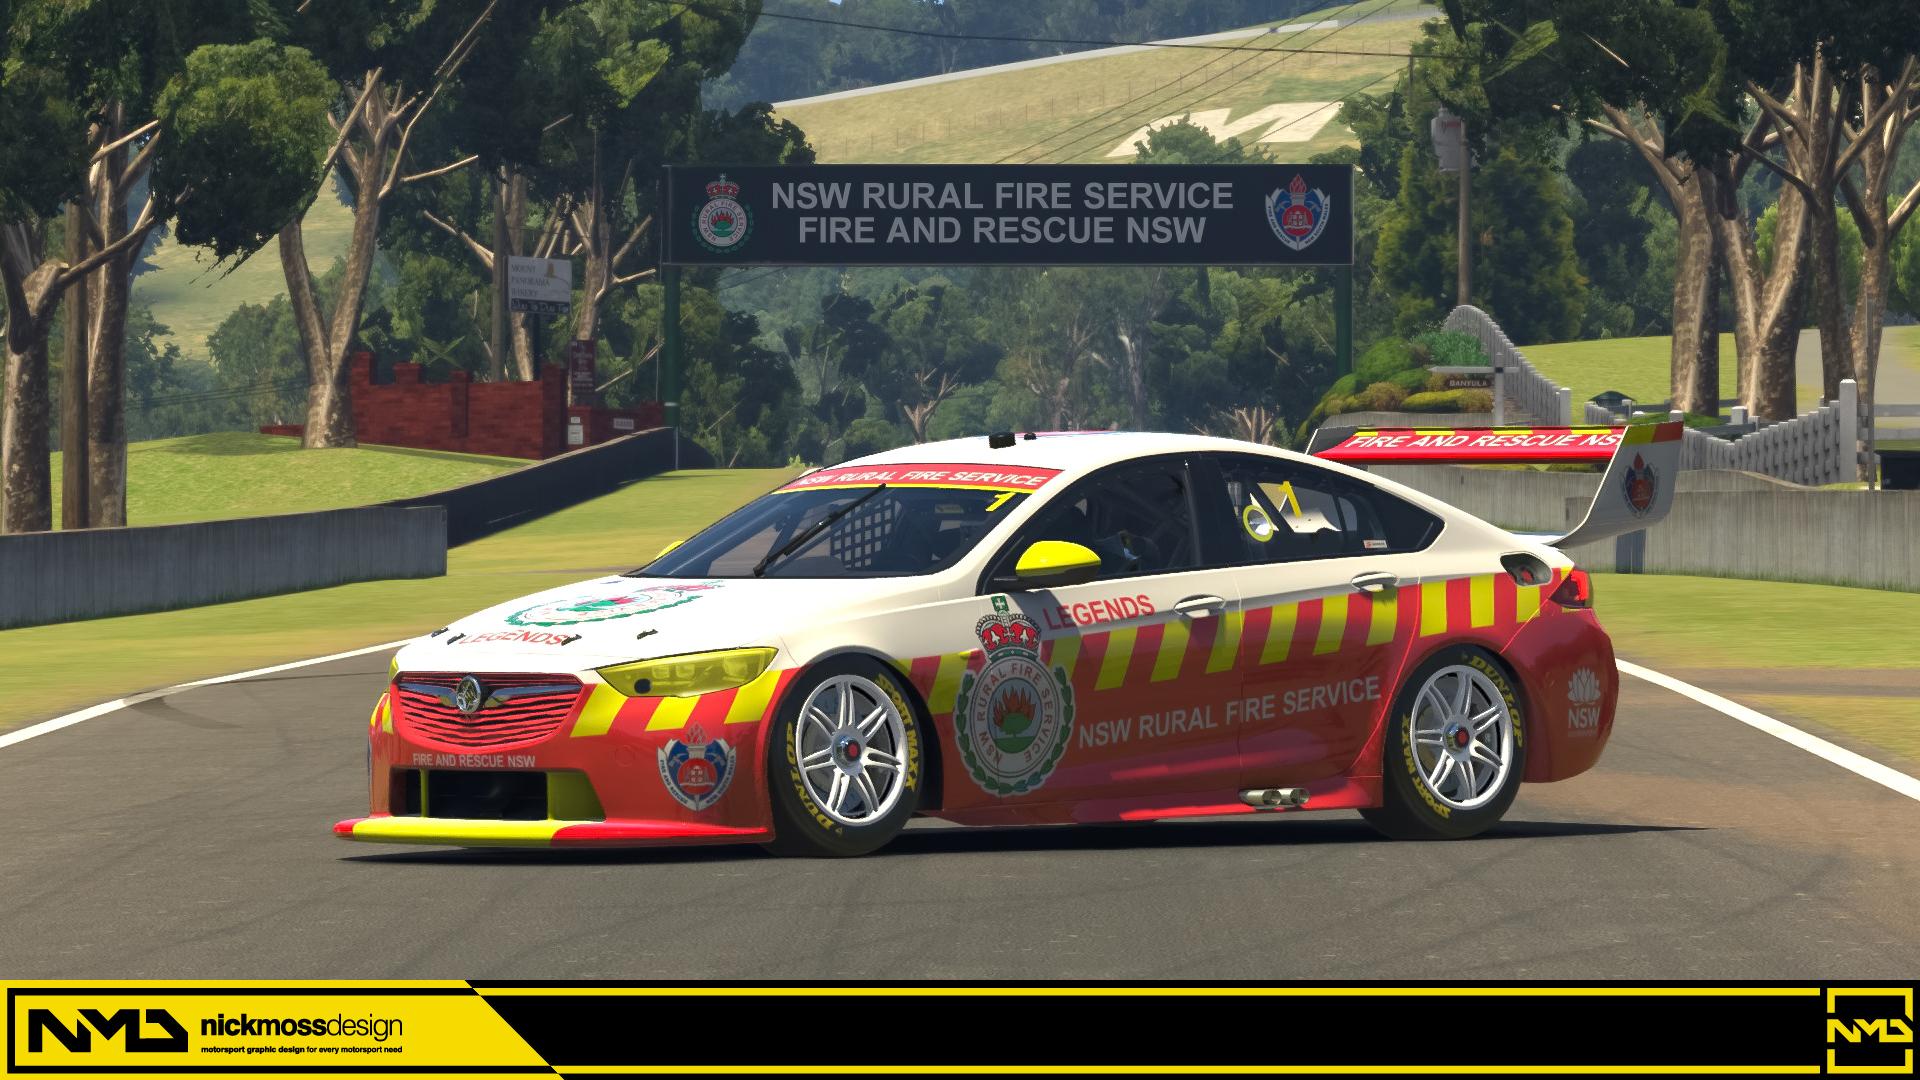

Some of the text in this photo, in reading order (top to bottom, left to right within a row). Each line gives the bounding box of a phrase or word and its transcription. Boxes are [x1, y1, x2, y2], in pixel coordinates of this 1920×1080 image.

[772, 182, 1233, 209] NSW RURAL FIRE SERVICE
[799, 216, 1206, 244] FIRE AND RESCUE NSW
[1345, 434, 1622, 448] FIRE AND RESCUE NS
[835, 471, 898, 483] RURAL
[899, 471, 945, 482] FIRE
[948, 471, 1048, 487] SERVICE
[985, 491, 1017, 512] 1
[1278, 481, 1302, 518] 1
[1041, 594, 1155, 630] LEGENDS
[458, 629, 566, 646] LEGENDS
[976, 663, 1054, 766] NSW RURAL FIRE SERVICE
[1078, 676, 1381, 749] NSW RURAL FIRE SERVICE
[1469, 656, 1523, 748] DUNLOP
[1568, 708, 1600, 729] NSW
[412, 753, 536, 768] FIRE AND RESCUE NSW
[786, 721, 836, 831] DUNLOP
[905, 729, 919, 792] MAXX
[1401, 714, 1451, 819] SPORT MAXX
